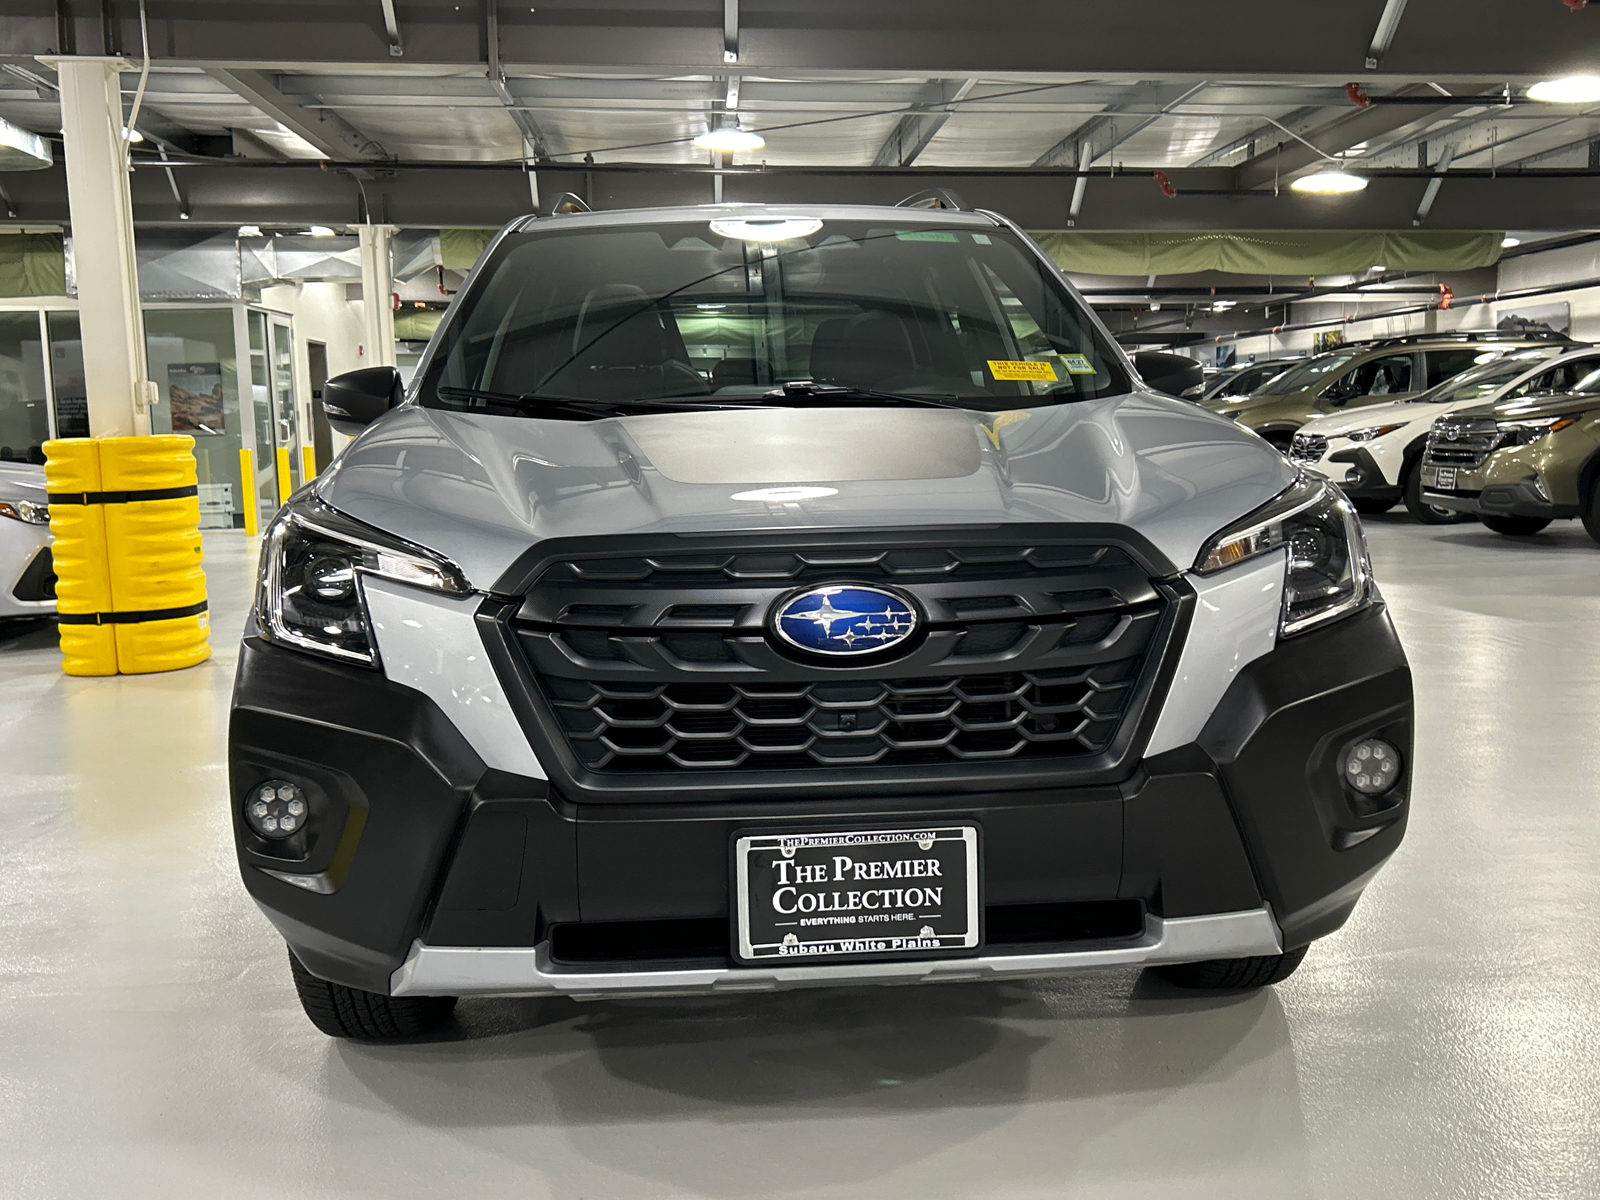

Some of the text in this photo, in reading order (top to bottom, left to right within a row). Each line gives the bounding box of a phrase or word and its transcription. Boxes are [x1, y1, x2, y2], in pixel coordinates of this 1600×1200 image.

[800, 912, 916, 926] EVERYTHING STARTS HERE.
[778, 937, 941, 956] Subaru White Plains
